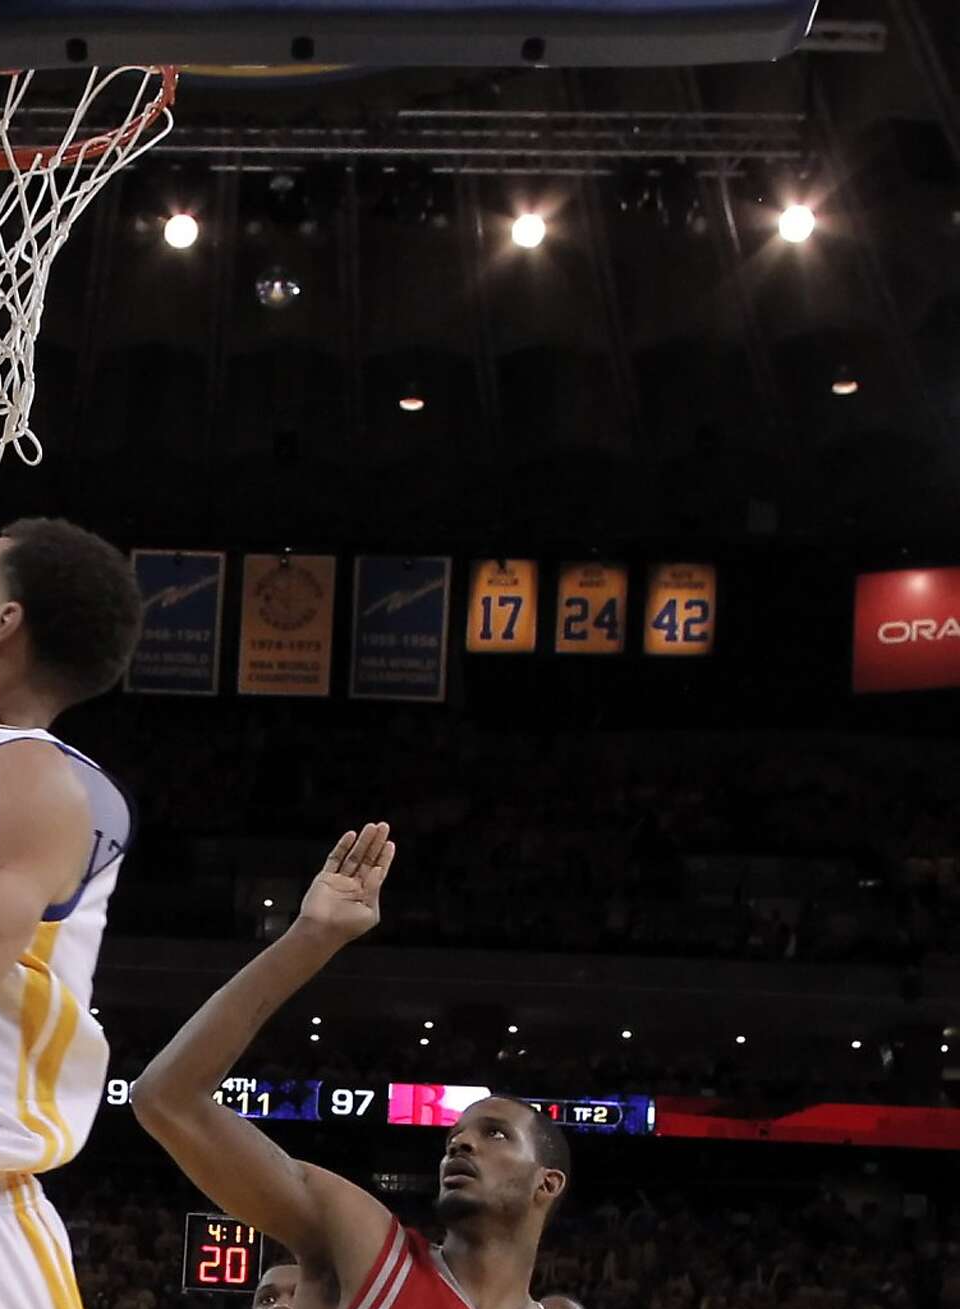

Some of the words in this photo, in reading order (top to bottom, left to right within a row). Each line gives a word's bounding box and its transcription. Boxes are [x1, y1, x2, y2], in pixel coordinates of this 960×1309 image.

[480, 595, 523, 641] 17
[562, 596, 620, 642] 24
[651, 597, 711, 643] 42
[107, 1079, 137, 1105] 9
[221, 1078, 257, 1093] 4TH
[331, 1088, 375, 1117] 97
[208, 1223, 255, 1244] 4:11
[200, 1245, 246, 1283] 20
